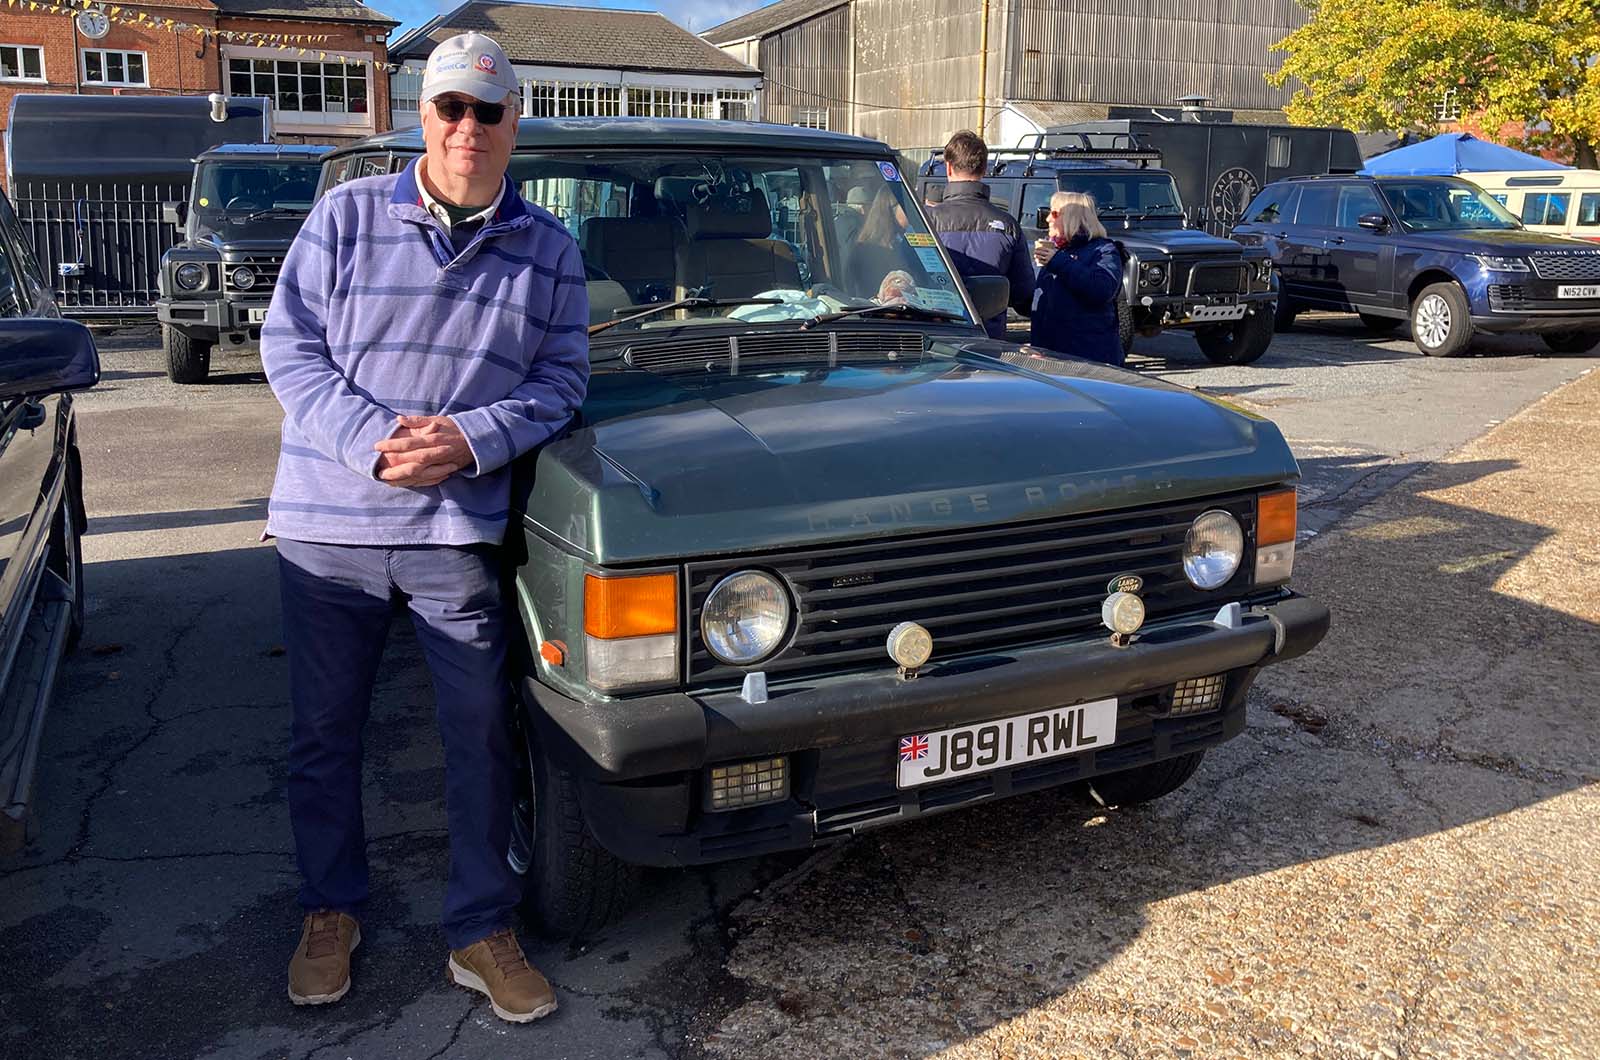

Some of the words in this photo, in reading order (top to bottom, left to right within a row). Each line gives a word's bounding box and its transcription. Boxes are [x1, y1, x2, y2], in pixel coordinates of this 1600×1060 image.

[807, 493, 991, 531] RANGE
[923, 722, 1014, 777] J891
[1027, 708, 1098, 757] RWL
